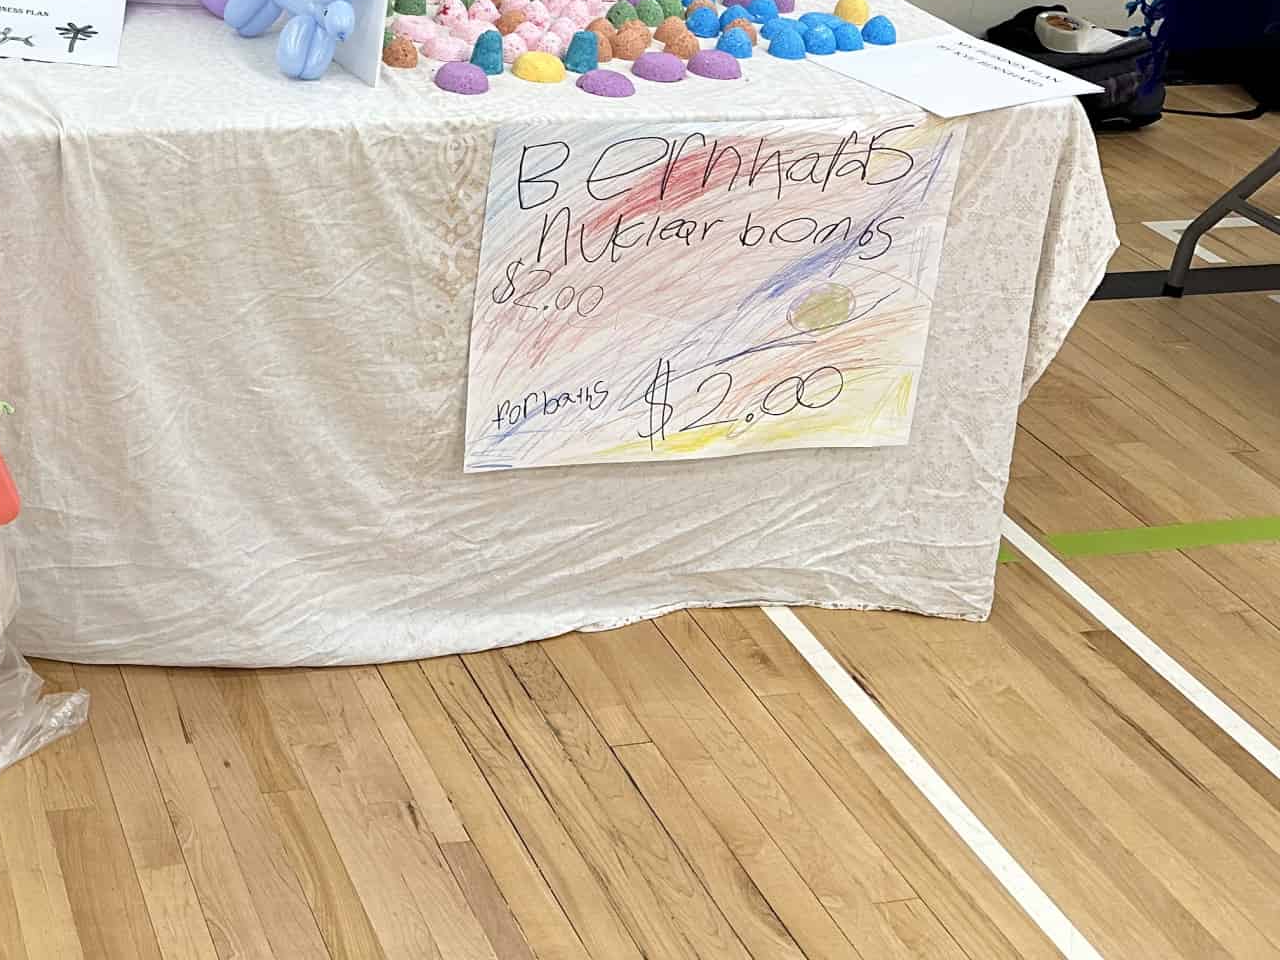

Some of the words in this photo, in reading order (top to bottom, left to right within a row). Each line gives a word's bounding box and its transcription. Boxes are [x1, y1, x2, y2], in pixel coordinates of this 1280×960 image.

[26, 7, 49, 17] PLAN
[492, 257, 604, 318] $2.00
[637, 357, 844, 452] $2.00
